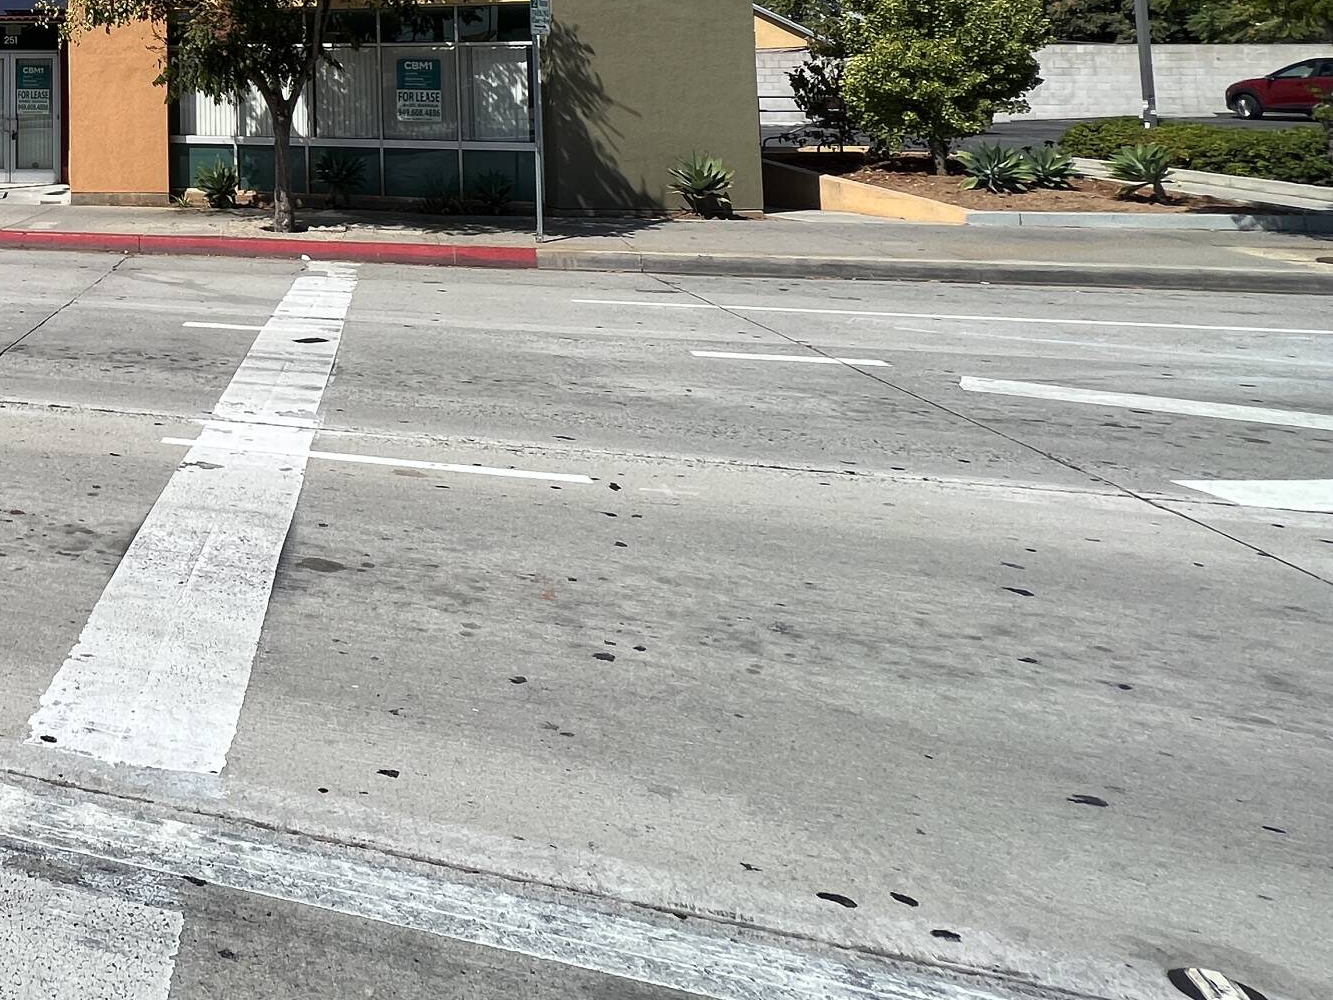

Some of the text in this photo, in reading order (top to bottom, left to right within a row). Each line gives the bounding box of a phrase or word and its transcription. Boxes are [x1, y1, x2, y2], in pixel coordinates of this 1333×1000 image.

[3, 35, 18, 45] 251
[404, 61, 433, 70] CBM1
[18, 90, 49, 99] FOR LEASE
[398, 91, 440, 103] FOR LEASE
